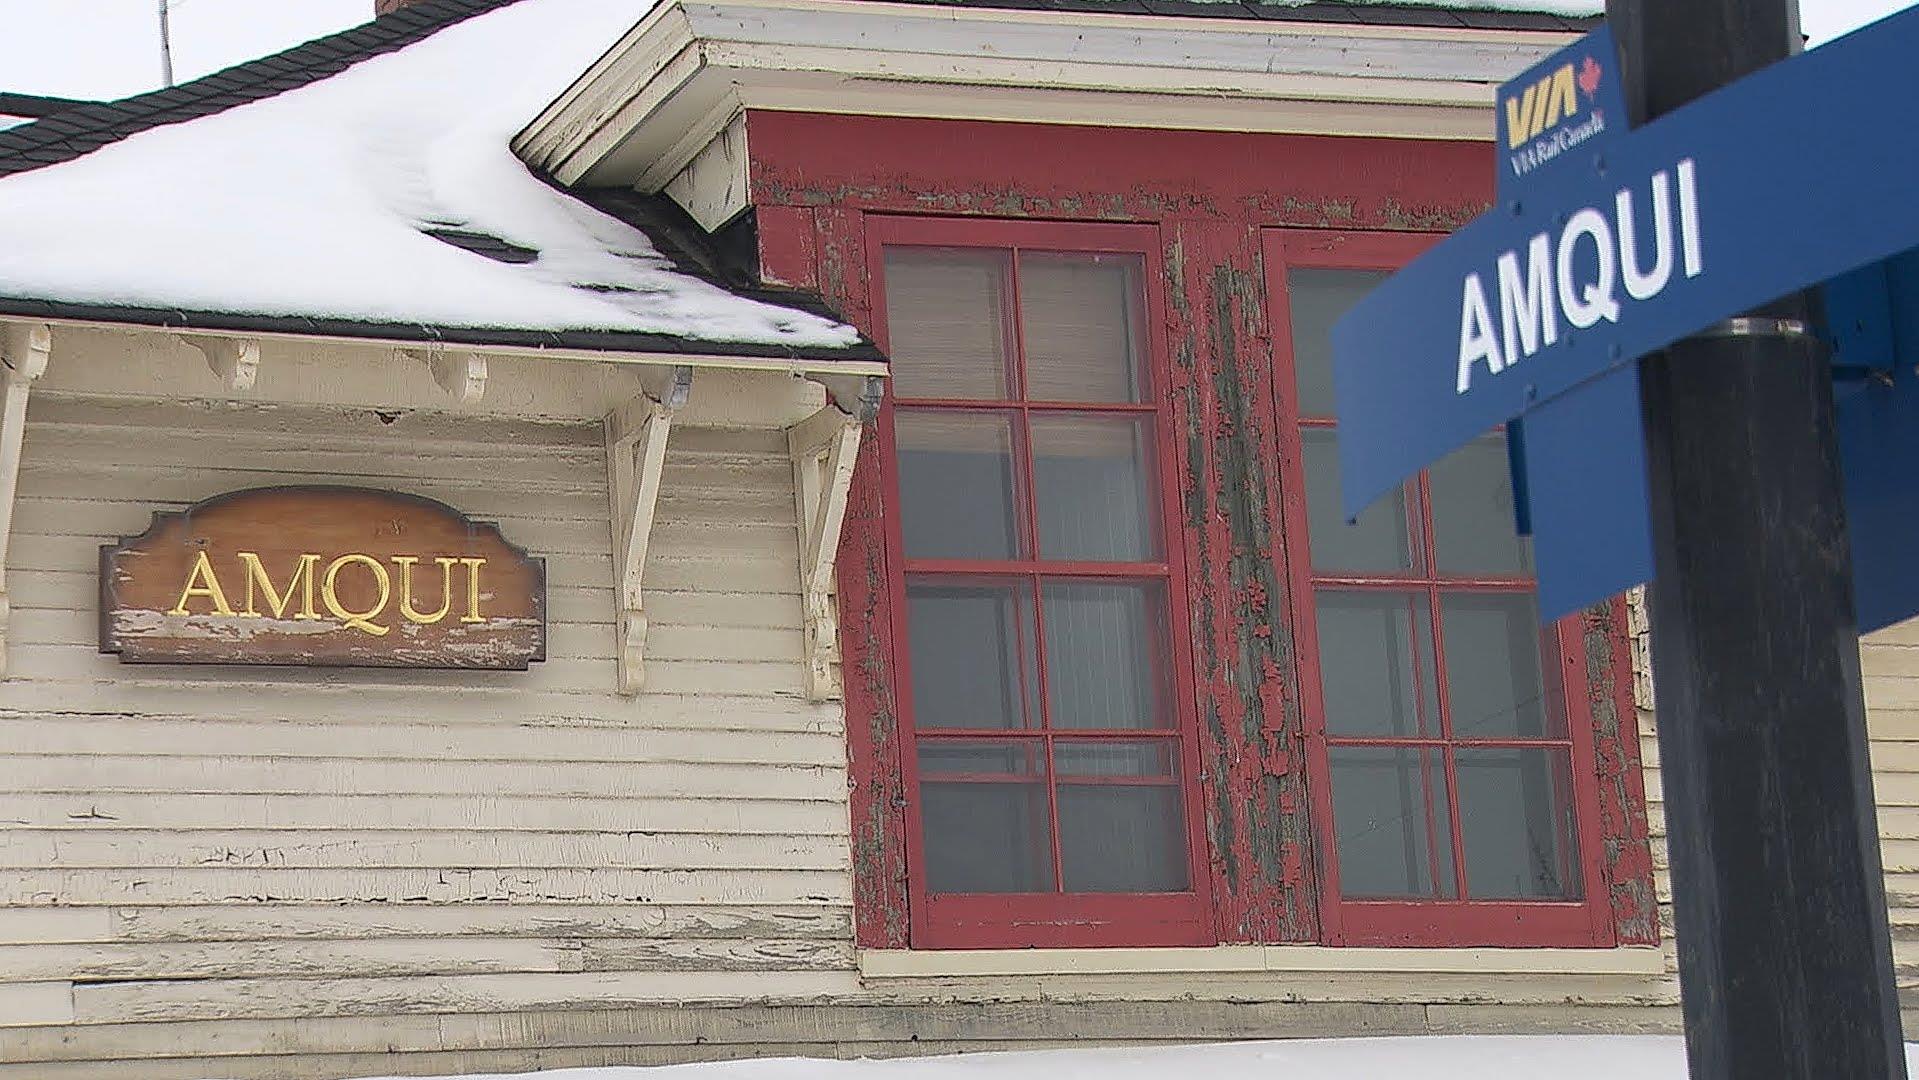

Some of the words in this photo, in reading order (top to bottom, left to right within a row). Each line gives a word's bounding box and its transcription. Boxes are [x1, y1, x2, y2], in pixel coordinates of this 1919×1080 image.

[1507, 64, 1577, 149] VIA
[1511, 148, 1536, 177] VIA
[1535, 132, 1561, 165] Rail
[1560, 109, 1604, 150] Canada
[1456, 158, 1702, 394] AMQUI
[168, 551, 487, 635] AMQUI
